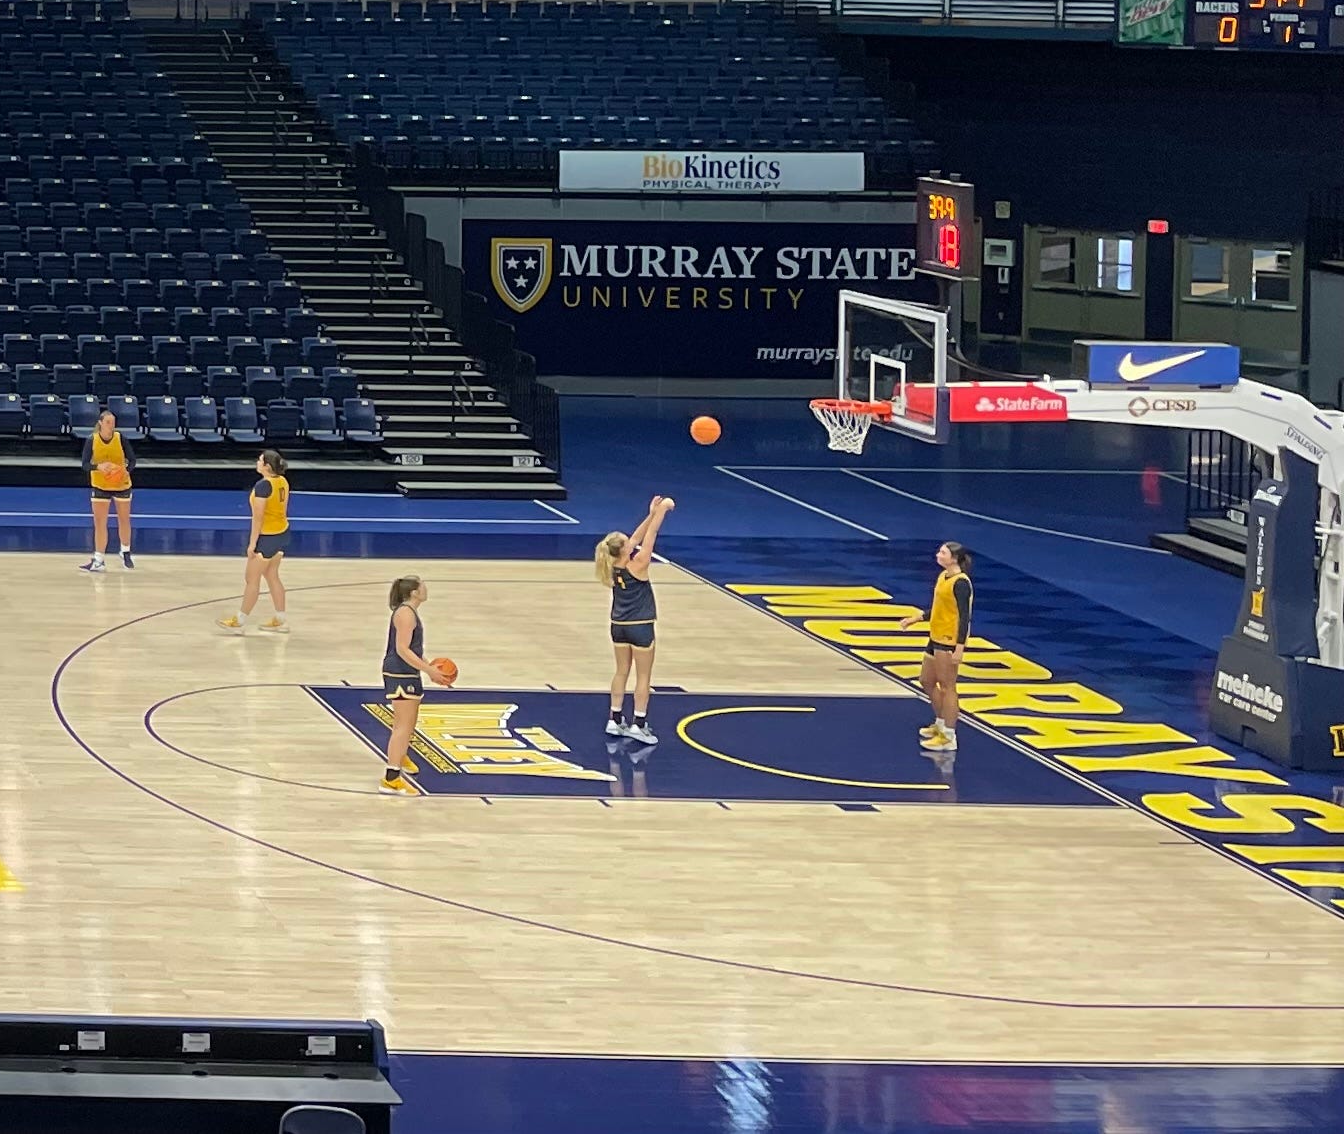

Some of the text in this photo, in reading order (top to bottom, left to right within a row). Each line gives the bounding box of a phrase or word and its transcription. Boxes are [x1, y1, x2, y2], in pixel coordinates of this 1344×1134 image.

[1196, 1, 1239, 14] RACERS
[1218, 17, 1238, 43] 0
[643, 154, 781, 181] BioKinetics
[643, 179, 782, 190] PHYSICAL THERAPY
[929, 194, 955, 221] 39.9
[559, 244, 916, 281] MURRAY STATE
[563, 286, 805, 310] UNIVERSITY
[1152, 399, 1197, 412] CFSB
[725, 584, 1289, 787] MURRAY
[1216, 670, 1283, 713] meineke
[1219, 691, 1277, 723] car care center
